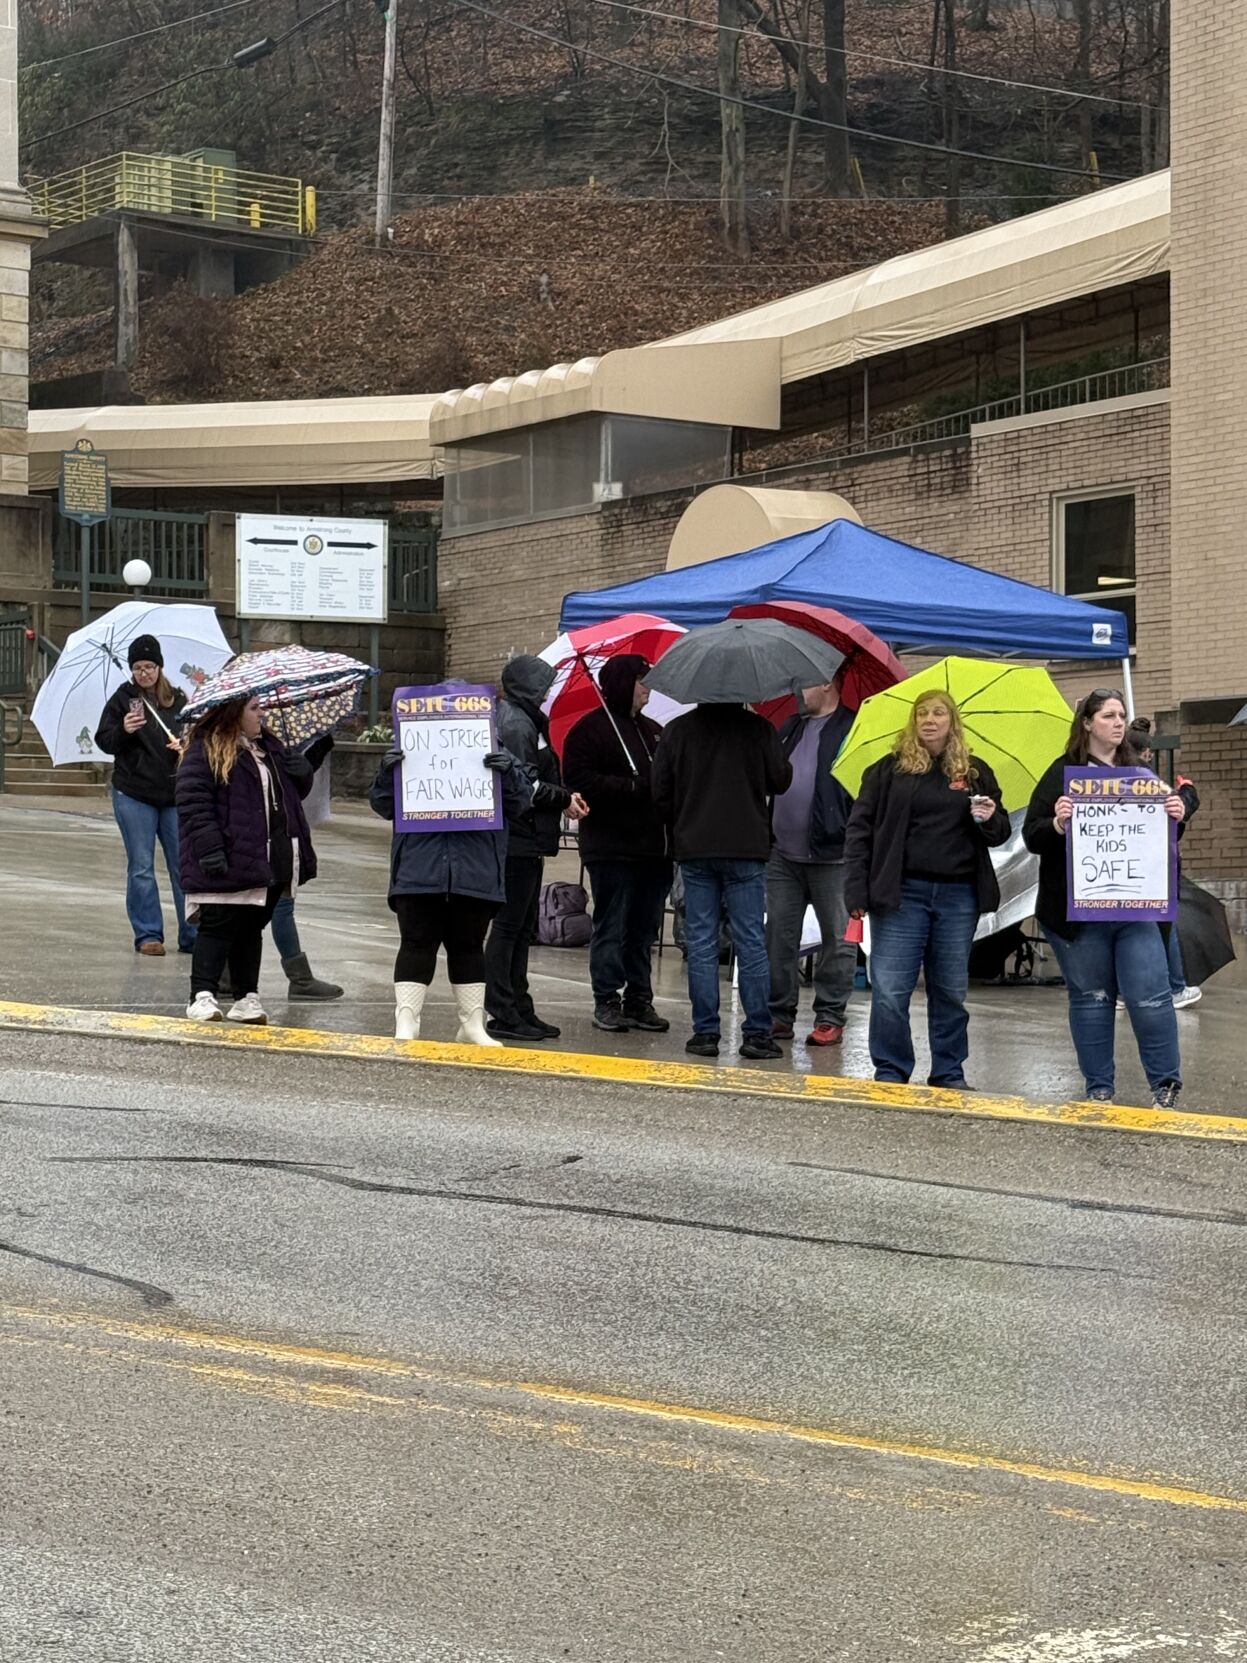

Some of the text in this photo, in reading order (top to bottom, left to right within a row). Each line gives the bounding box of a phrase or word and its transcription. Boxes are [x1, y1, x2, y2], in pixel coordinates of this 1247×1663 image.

[396, 695, 492, 713] SEIU 668
[404, 728, 489, 752] ON STRIKE
[429, 754, 459, 771] for
[405, 777, 494, 801] FAIR WAGES
[1068, 778, 1173, 796] SEIU 668
[402, 810, 495, 821] STRONGER TOGETHER
[1076, 804, 1117, 819] HONK
[1137, 804, 1156, 814] TO
[1079, 822, 1146, 837] KEEP THE
[1096, 838, 1127, 853] KIDS
[1081, 855, 1146, 883] SAFE
[1073, 900, 1169, 909] STRONGER TOGETHER
